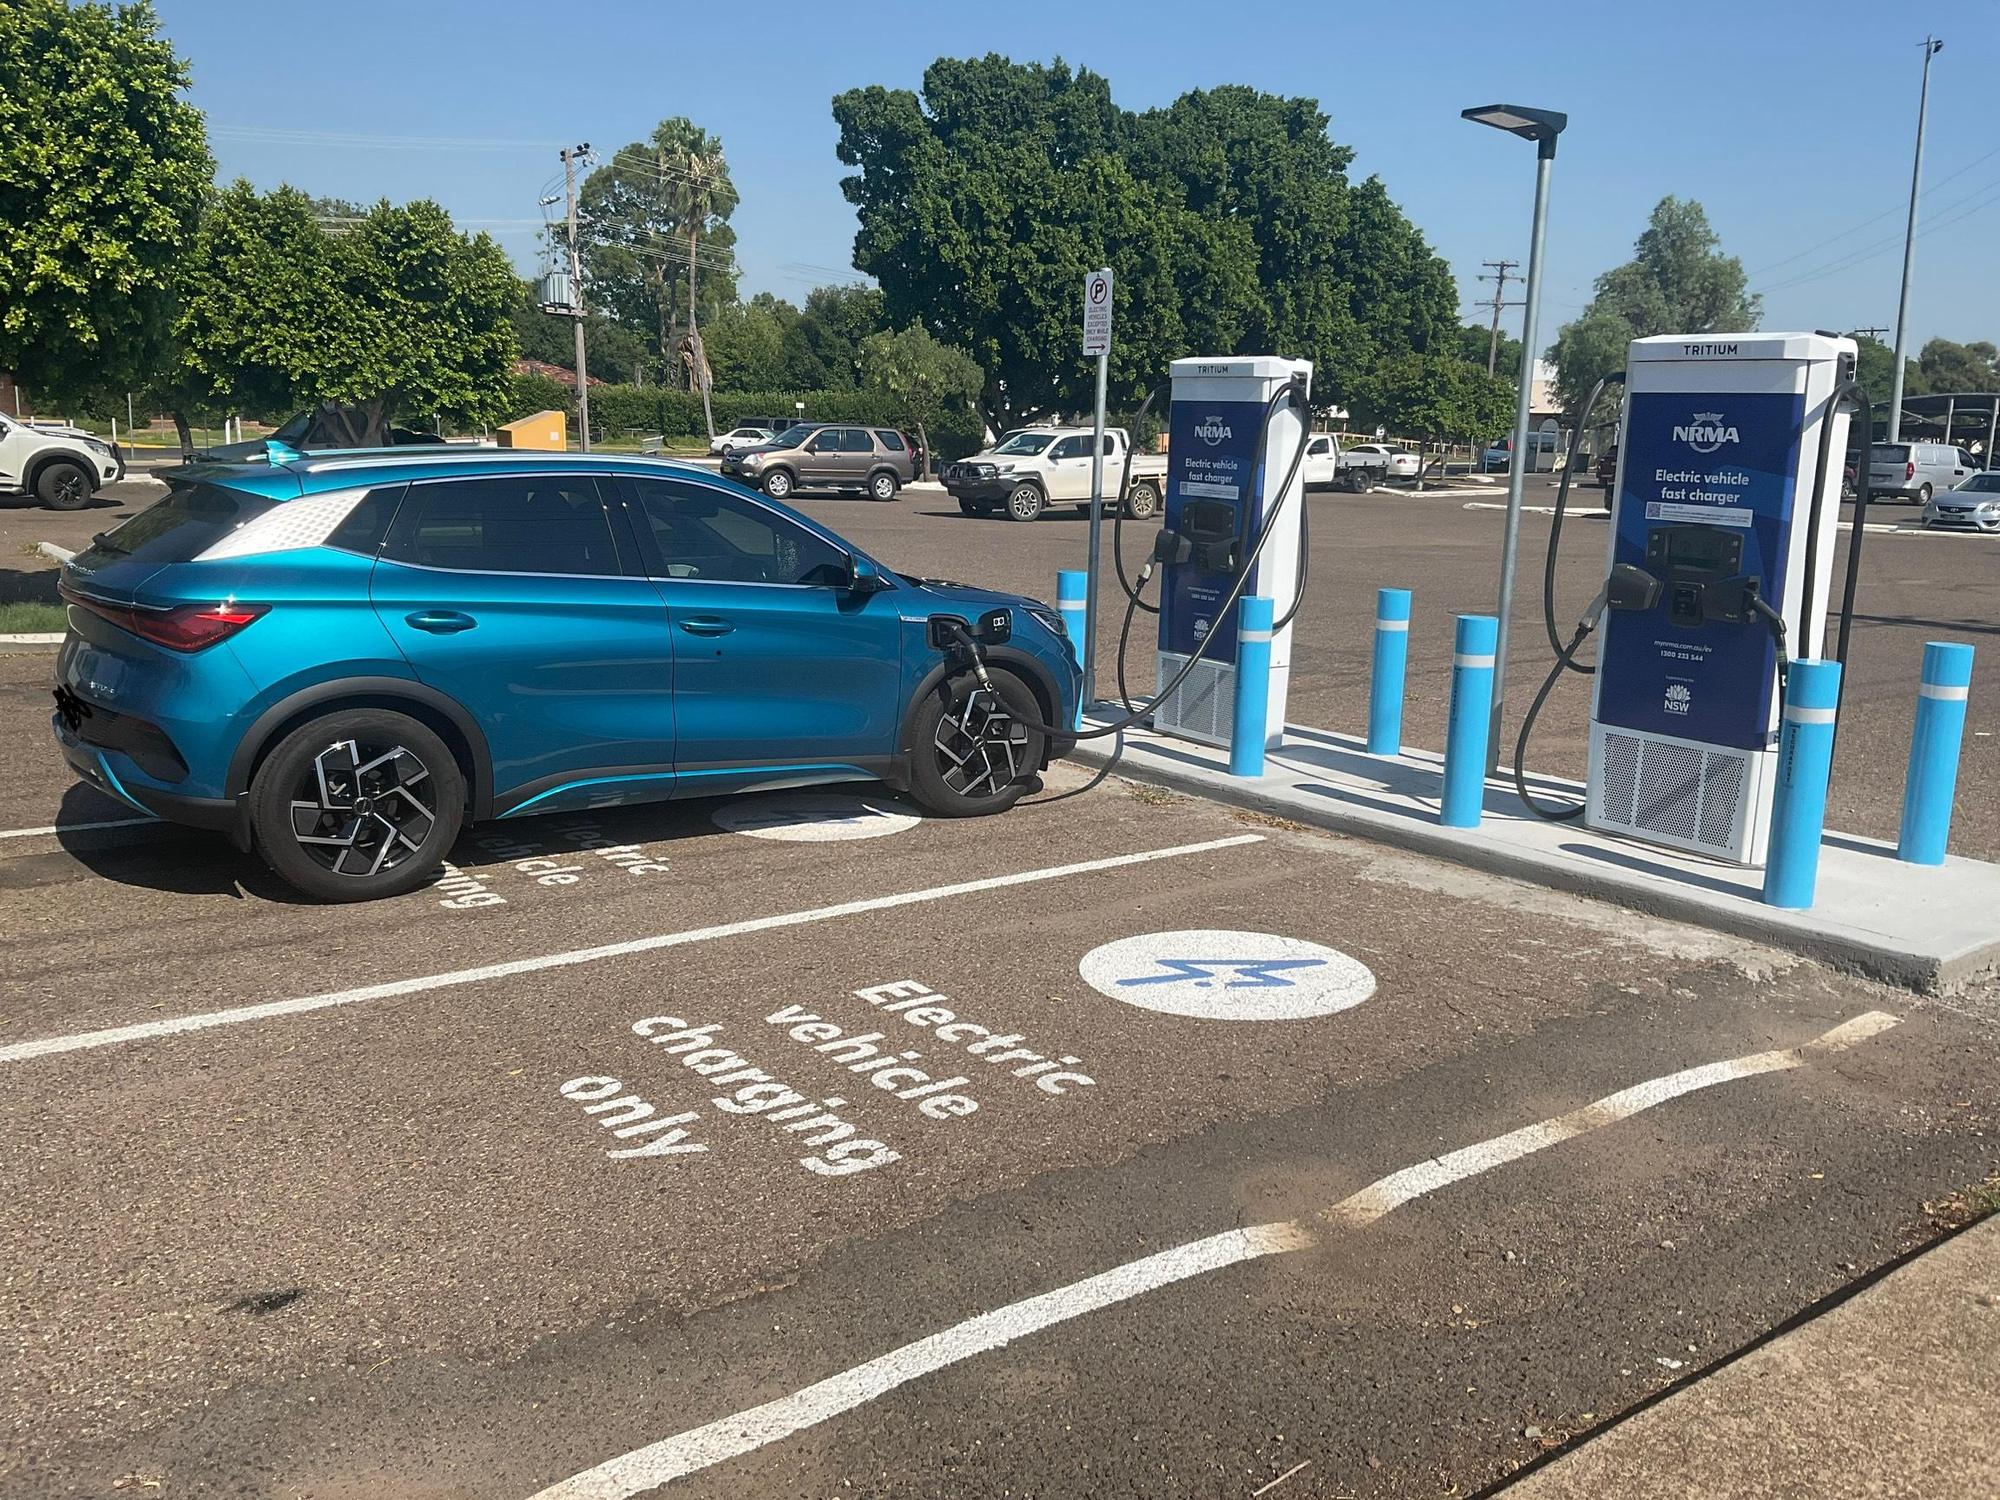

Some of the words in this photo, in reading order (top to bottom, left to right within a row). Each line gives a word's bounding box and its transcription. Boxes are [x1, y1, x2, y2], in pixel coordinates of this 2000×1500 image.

[1684, 344, 1738, 356] TRITIUM
[1197, 365, 1229, 374] TRITIUM
[1194, 424, 1232, 439] NRMA
[1672, 425, 1740, 443] NRMA
[1185, 458, 1211, 468] Electric
[1212, 460, 1238, 470] vehicle
[1188, 471, 1203, 481] fast
[1204, 472, 1233, 485] charger
[1655, 469, 1701, 484] Electric
[1703, 473, 1750, 486] vehicle
[1661, 487, 1686, 500] fast
[1689, 488, 1740, 505] charger
[1661, 650, 1676, 658] 1300
[1664, 700, 1690, 713] NSW
[854, 979, 1095, 1095] Electric
[765, 1004, 979, 1120] vehicle
[631, 1015, 902, 1177] charging
[559, 1075, 708, 1160] only
